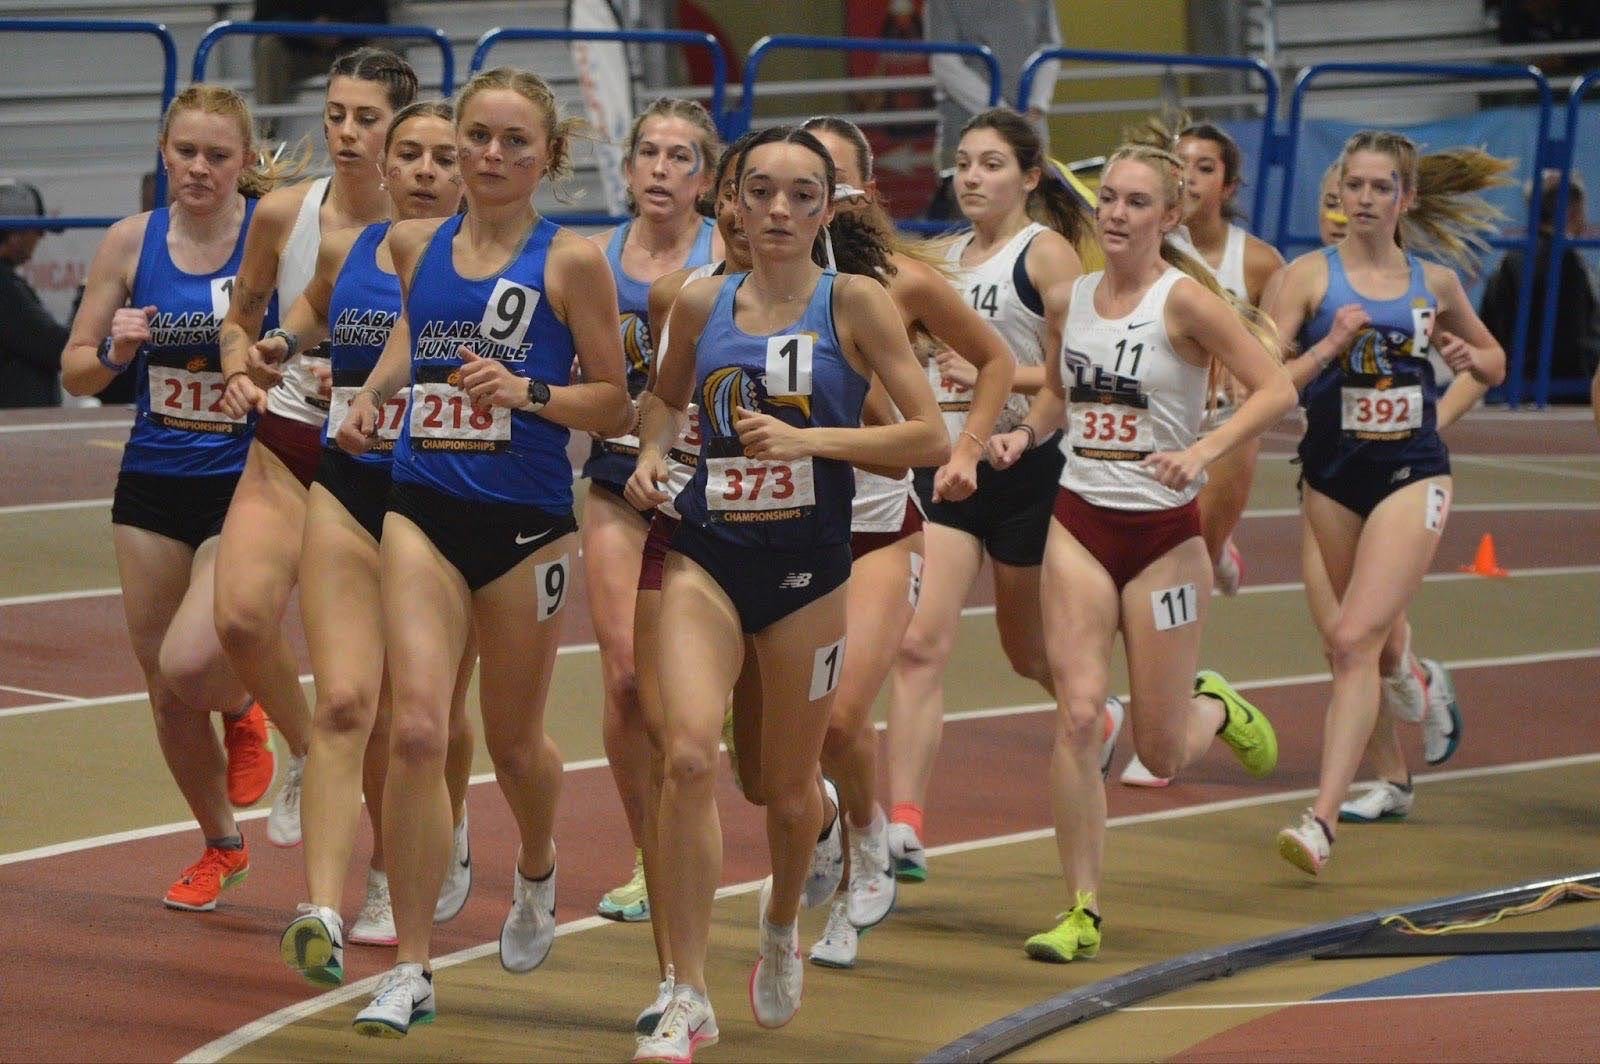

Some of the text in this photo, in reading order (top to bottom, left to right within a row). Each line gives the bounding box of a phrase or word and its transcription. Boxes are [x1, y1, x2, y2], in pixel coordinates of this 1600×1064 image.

[489, 286, 527, 341] 9
[971, 284, 998, 318] 14
[778, 338, 799, 393] 1
[1115, 338, 1144, 377] 11
[164, 378, 225, 413] 212
[1074, 363, 1142, 393] LEE
[163, 417, 233, 433] CHAMPIONSHIPS
[422, 394, 494, 431] 218
[1082, 411, 1138, 443] 335
[1357, 396, 1410, 424] 392
[422, 439, 496, 451] CHAMPIONSHIPS
[722, 465, 795, 501] 373
[724, 509, 802, 522] CHAMPIONSHIPS
[545, 563, 565, 616] 9
[1160, 587, 1188, 626] 11
[824, 644, 839, 692] 1
